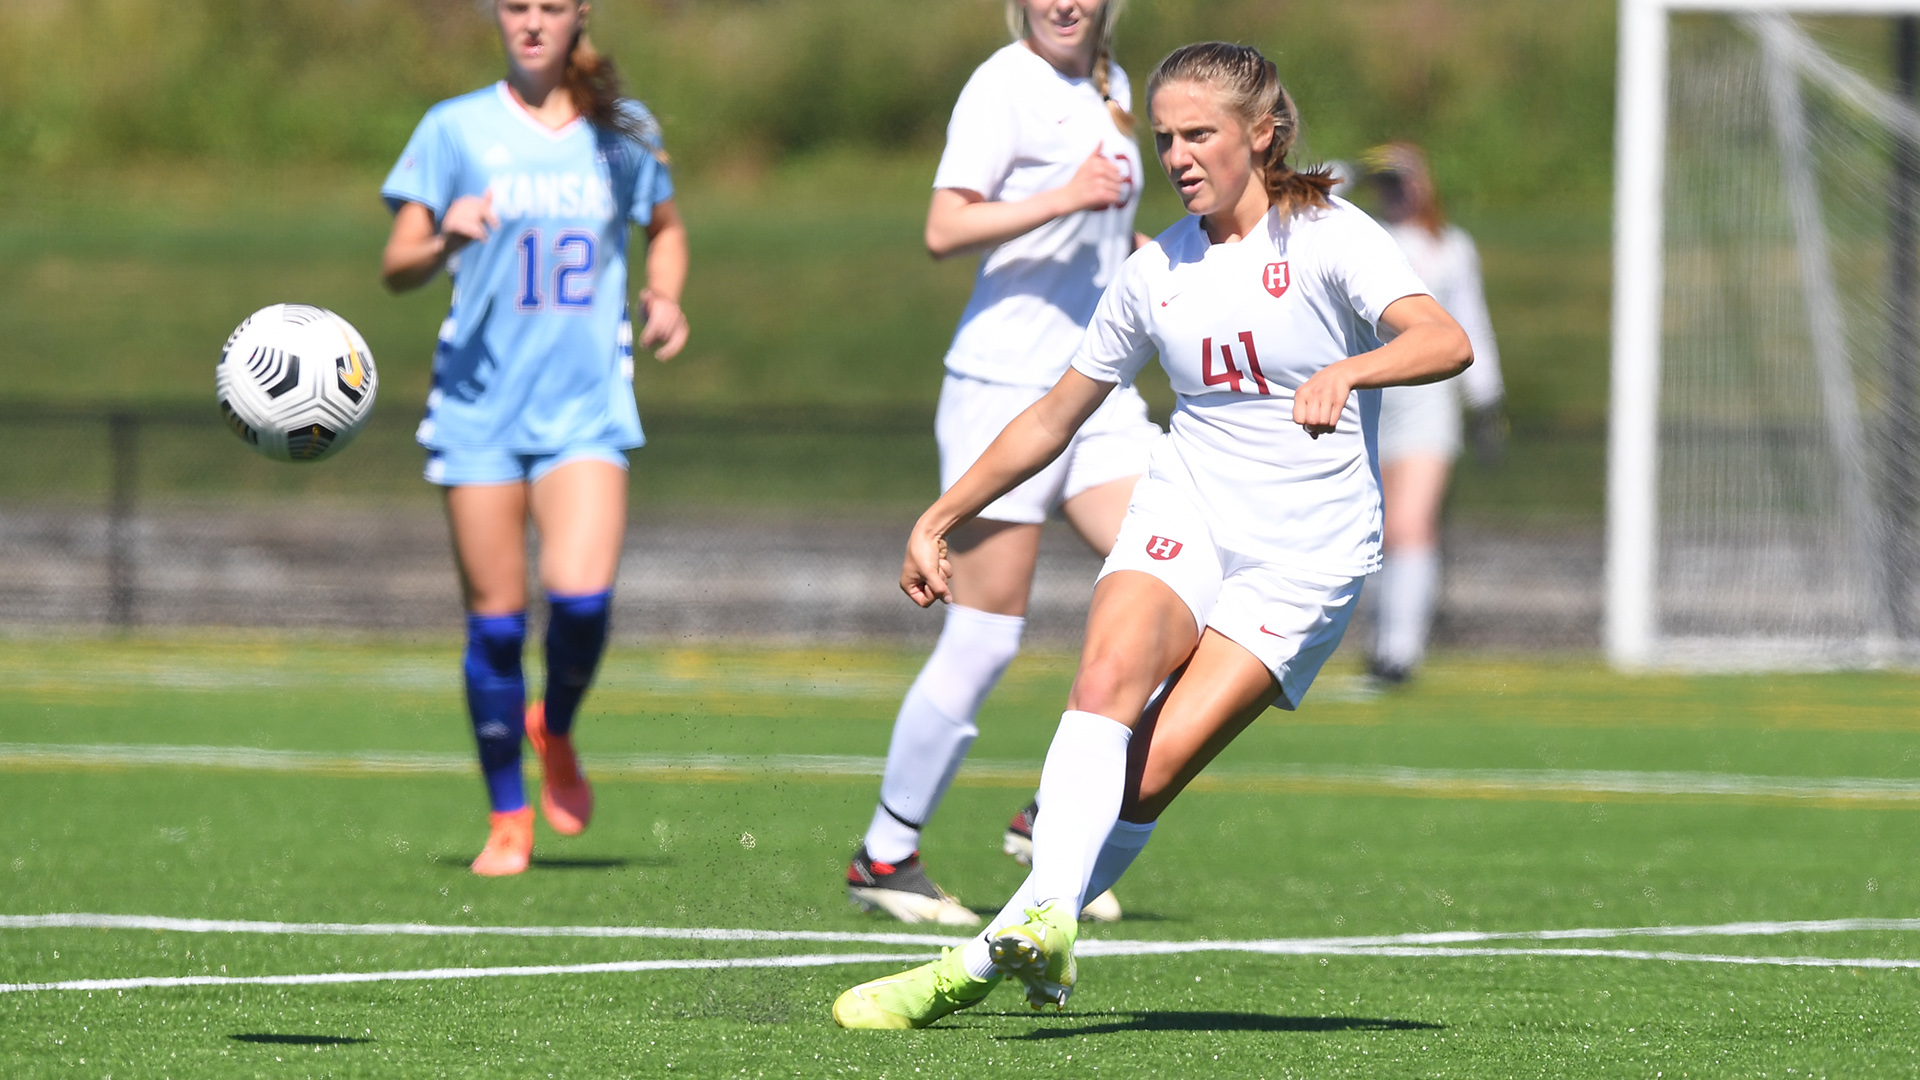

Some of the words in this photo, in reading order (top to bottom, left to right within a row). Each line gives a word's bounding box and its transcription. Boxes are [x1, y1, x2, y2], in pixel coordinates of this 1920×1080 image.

[515, 228, 599, 315] 12
[1267, 264, 1287, 289] H
[1203, 331, 1270, 395] 41
[1149, 537, 1177, 558] H
